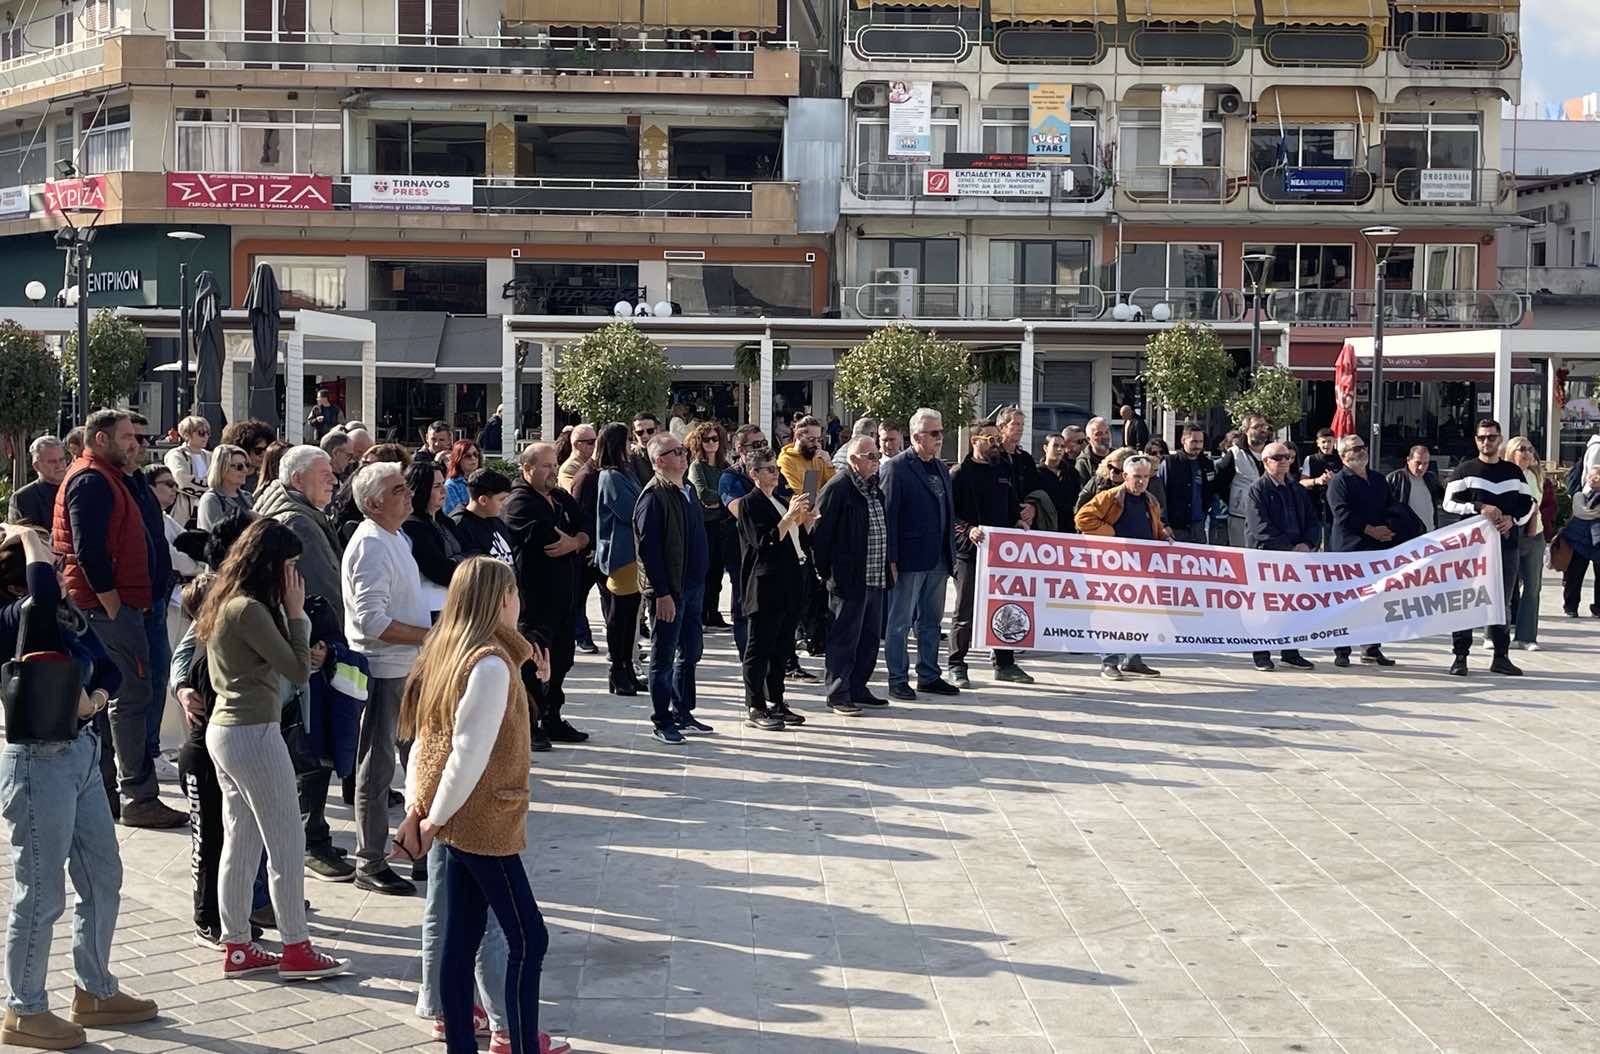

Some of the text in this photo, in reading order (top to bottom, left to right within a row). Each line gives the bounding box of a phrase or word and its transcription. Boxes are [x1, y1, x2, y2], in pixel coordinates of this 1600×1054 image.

[1032, 134, 1068, 144] LUCKY
[172, 174, 328, 204] ΣΥΡΙΖΑ
[392, 179, 450, 188] TIRNAVOS
[393, 188, 429, 196] PRESS
[87, 269, 139, 292] ΕΝΤΡΙΚΟΝ
[998, 526, 1486, 583] ΟΛΟΙ ΣΤΟΝ ΑΓΩΝΑ ΓΙΑ ΤΗΝ ΠΑΙΔΕΙΑ
[988, 556, 1487, 612] ΚΑΙ ΤΑ ΣΧΟΛΕΙΑ ΠΟΥ ΕΧΟΥΜΕ ΑΝΑΓΚΗ
[1383, 584, 1493, 623] ΣΗΜΕΡΑ
[1043, 626, 1149, 642] ΔΗΜΟΣ ΤΥΡΝΑΒΟΥ
[1174, 635, 1225, 645] ΣΧΟΛΙΚΕΣ
[1226, 636, 1291, 645] ΚΟΙΝΟΤΗΤΕΣ
[1310, 627, 1349, 640] ΦΟΡΕΙΣ
